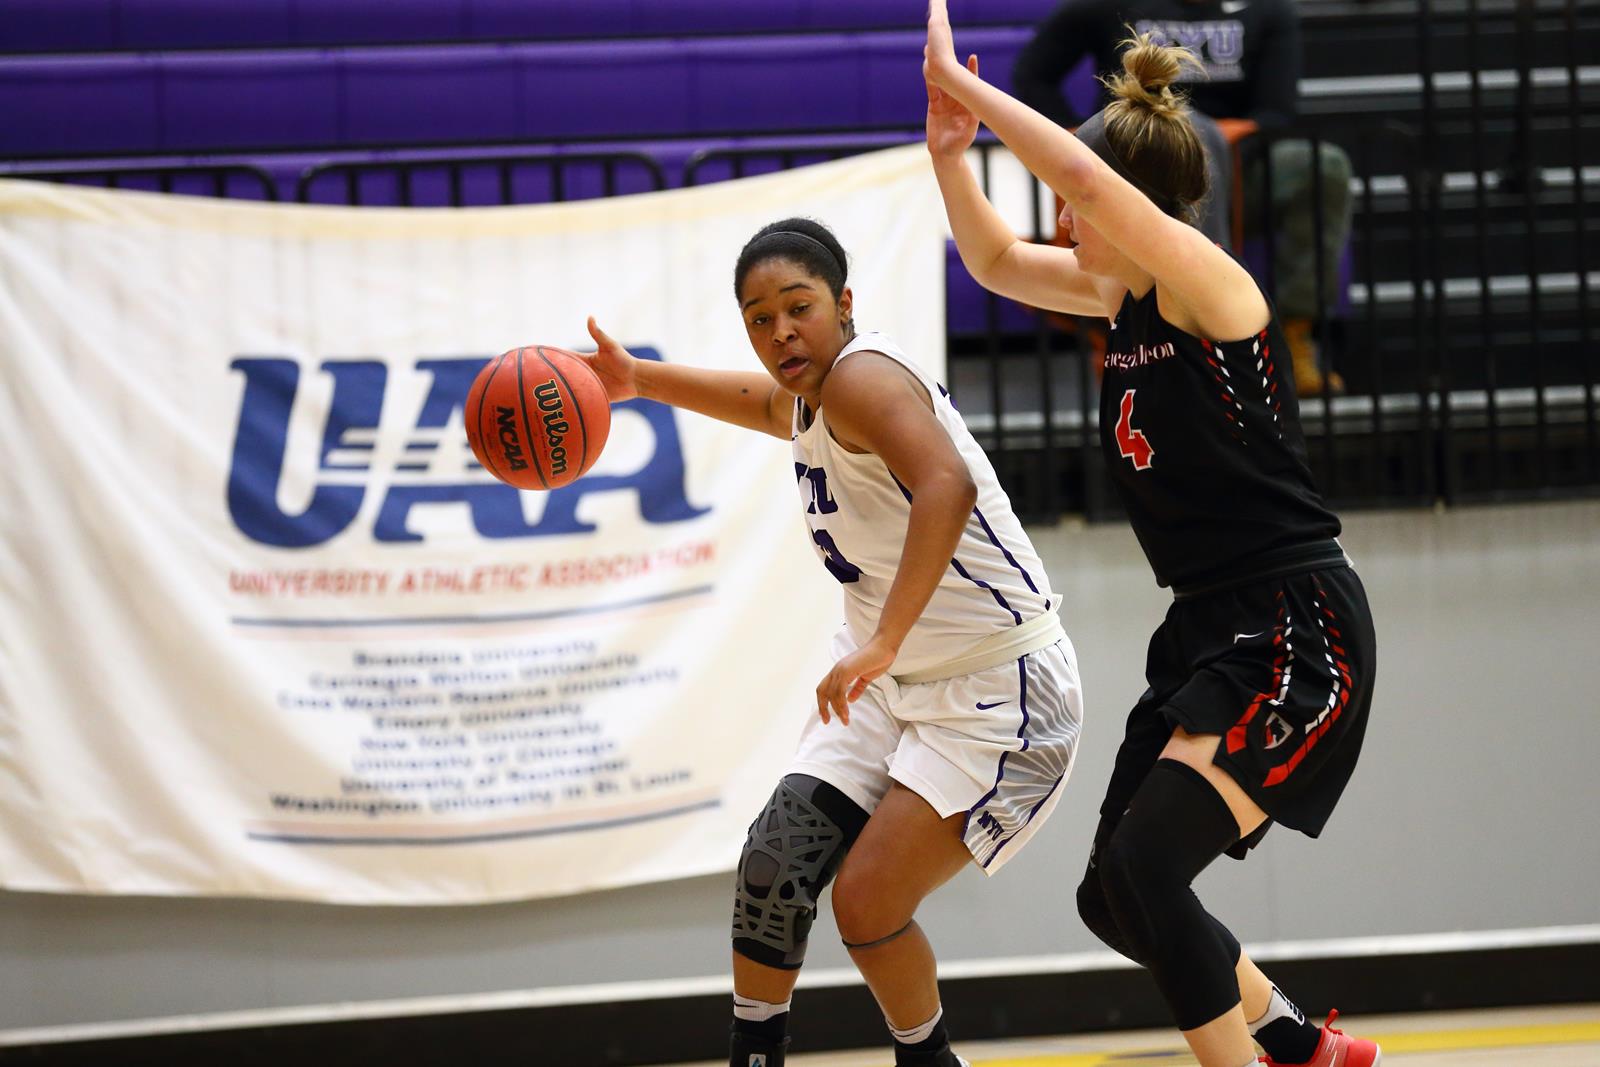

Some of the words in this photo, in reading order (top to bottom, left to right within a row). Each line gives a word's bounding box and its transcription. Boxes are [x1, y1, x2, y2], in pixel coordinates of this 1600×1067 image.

[225, 344, 713, 549] UAA
[496, 406, 528, 472] NCAA
[533, 379, 569, 476] Wilson
[1115, 389, 1155, 471] 4
[228, 570, 388, 597] UNIVERSITY
[399, 564, 530, 594] ATHLETIC
[538, 541, 717, 590] ASSOCIATION
